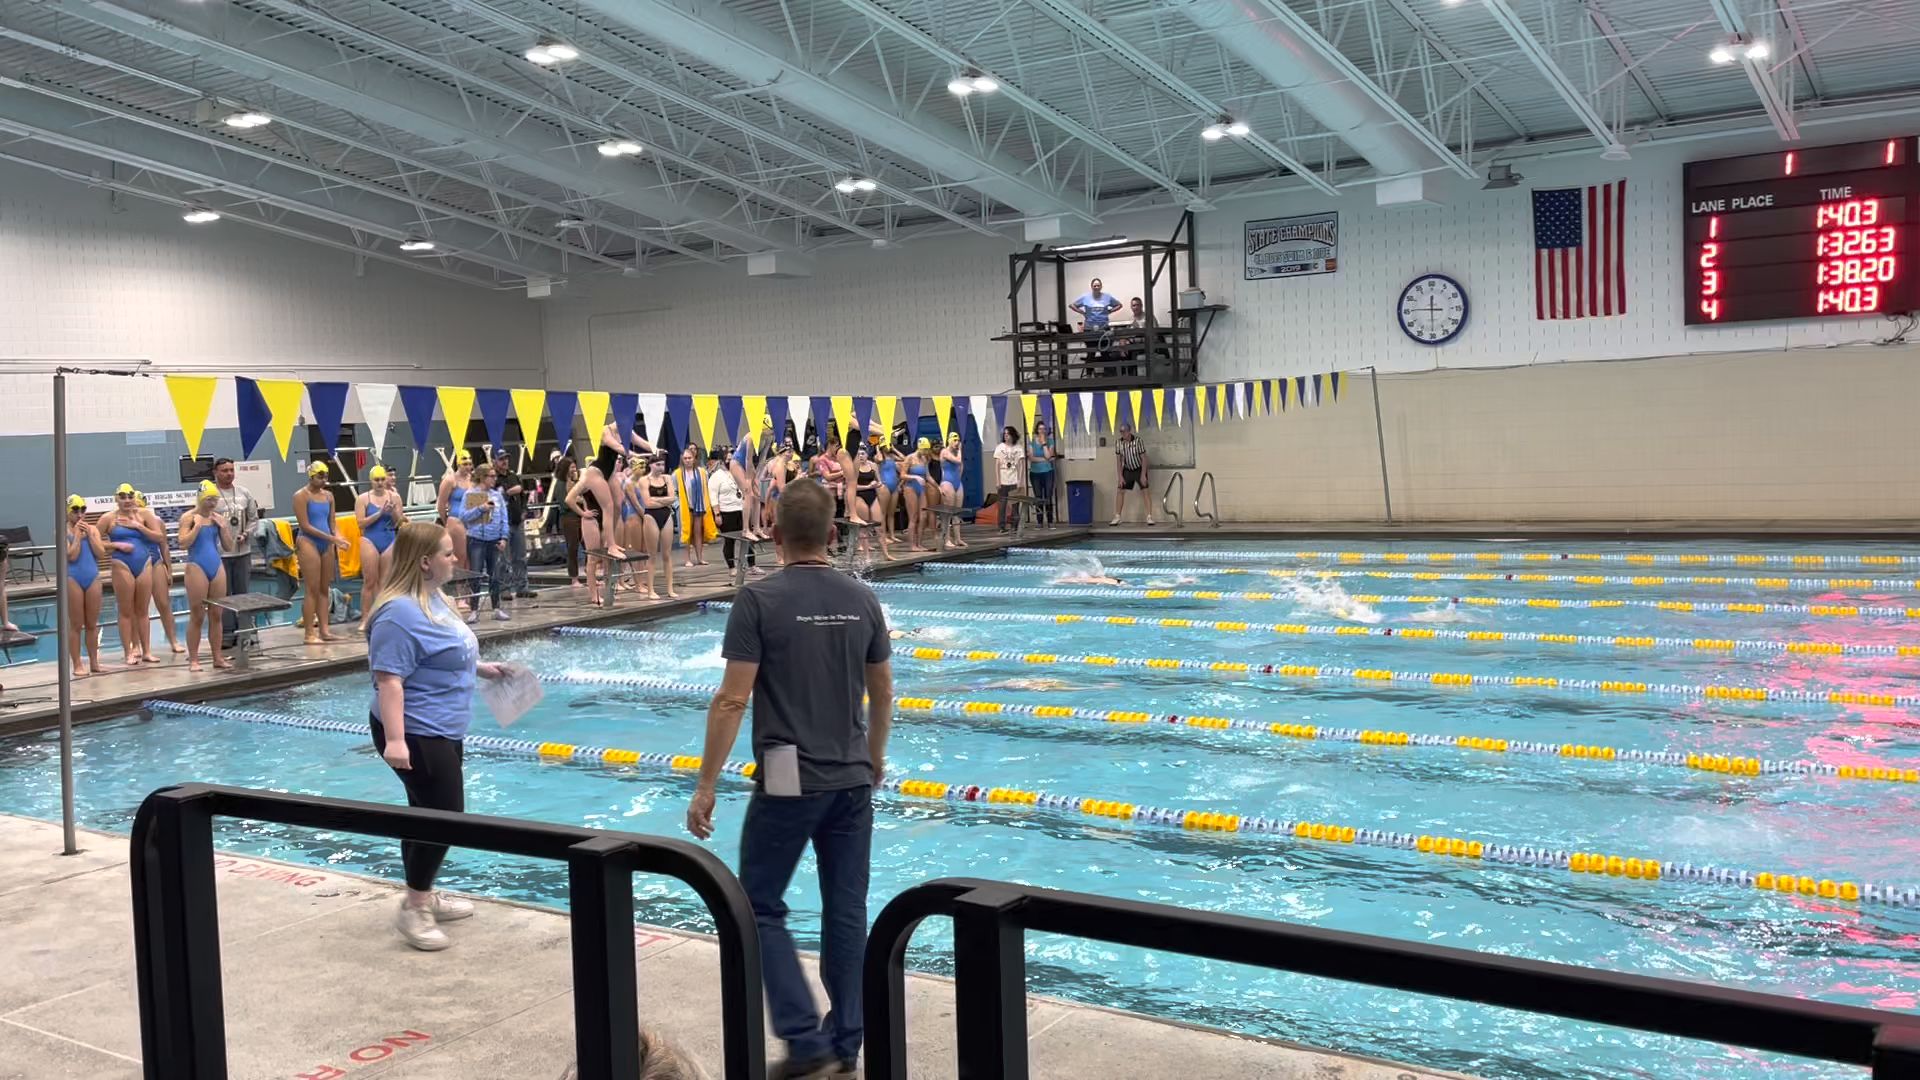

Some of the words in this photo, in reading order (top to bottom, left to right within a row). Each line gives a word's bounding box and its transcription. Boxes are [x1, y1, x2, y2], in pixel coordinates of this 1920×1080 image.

[1785, 152, 1793, 175] 1
[1886, 141, 1895, 164] 1
[1692, 199, 1725, 214] LANE
[1732, 194, 1773, 209] PLACE
[1820, 186, 1852, 200] TIME
[1247, 226, 1278, 255] STATE
[1279, 219, 1336, 247] CHAMPIONS
[1709, 216, 1718, 238] 1
[1283, 249, 1305, 262] SWIM
[1701, 243, 1717, 268] 2
[1701, 271, 1717, 295] 3
[1701, 298, 1717, 320] 4
[228, 863, 326, 887] DIVING
[349, 1029, 431, 1063] NO
